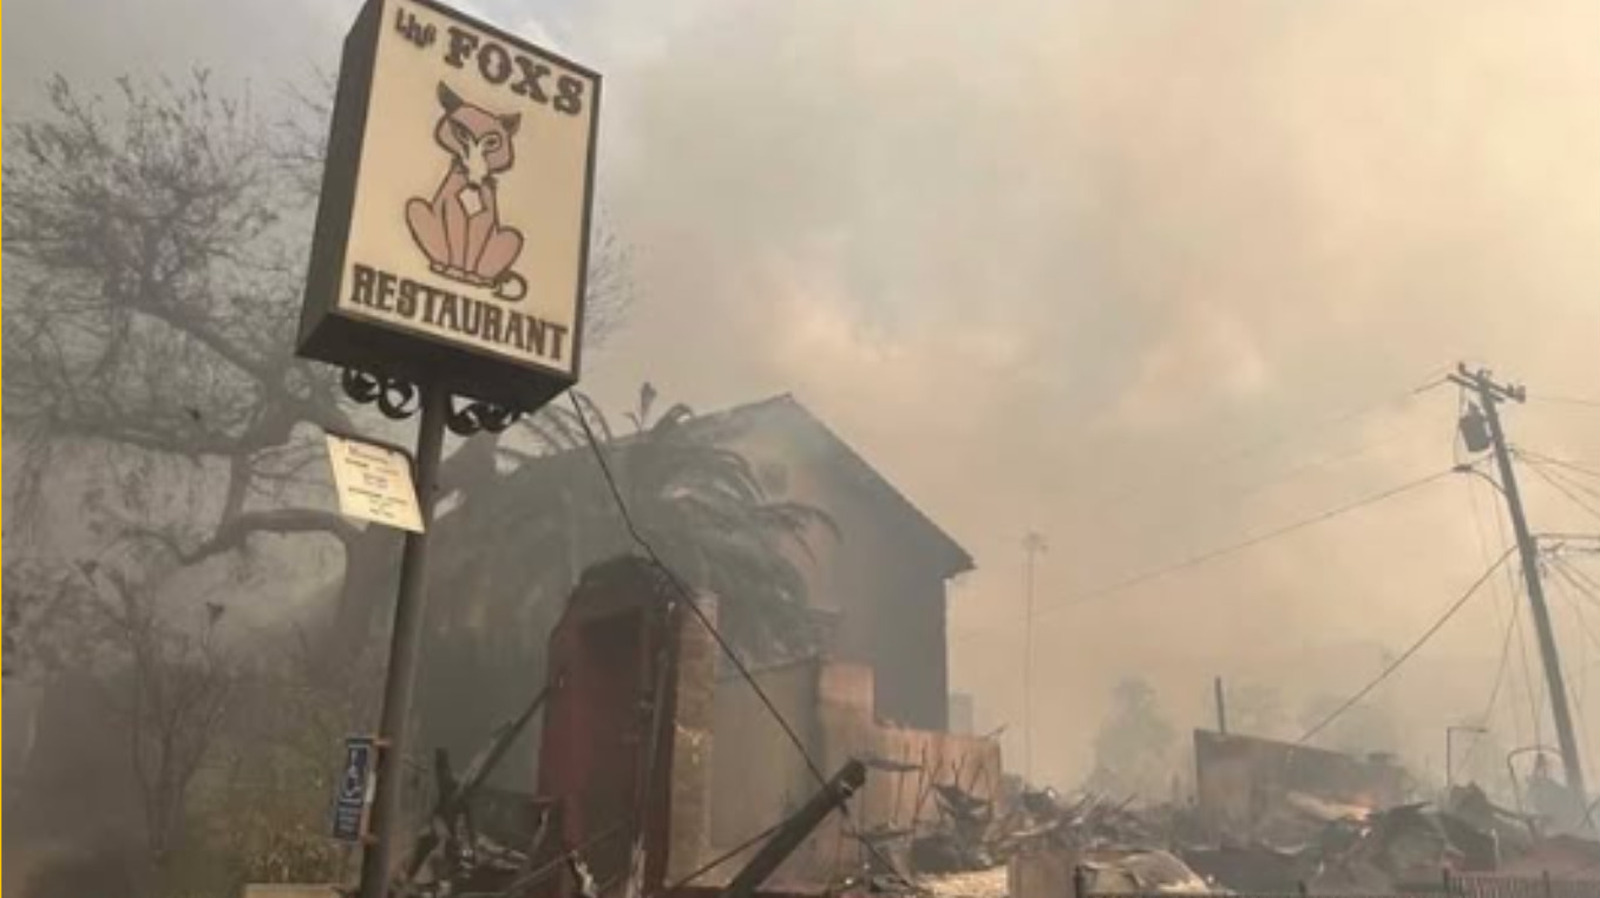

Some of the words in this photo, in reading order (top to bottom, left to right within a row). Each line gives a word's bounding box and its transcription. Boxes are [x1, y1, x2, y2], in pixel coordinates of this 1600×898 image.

[395, 7, 437, 48] the
[444, 26, 584, 115] FOXS
[351, 263, 568, 360] RESTAURANT
